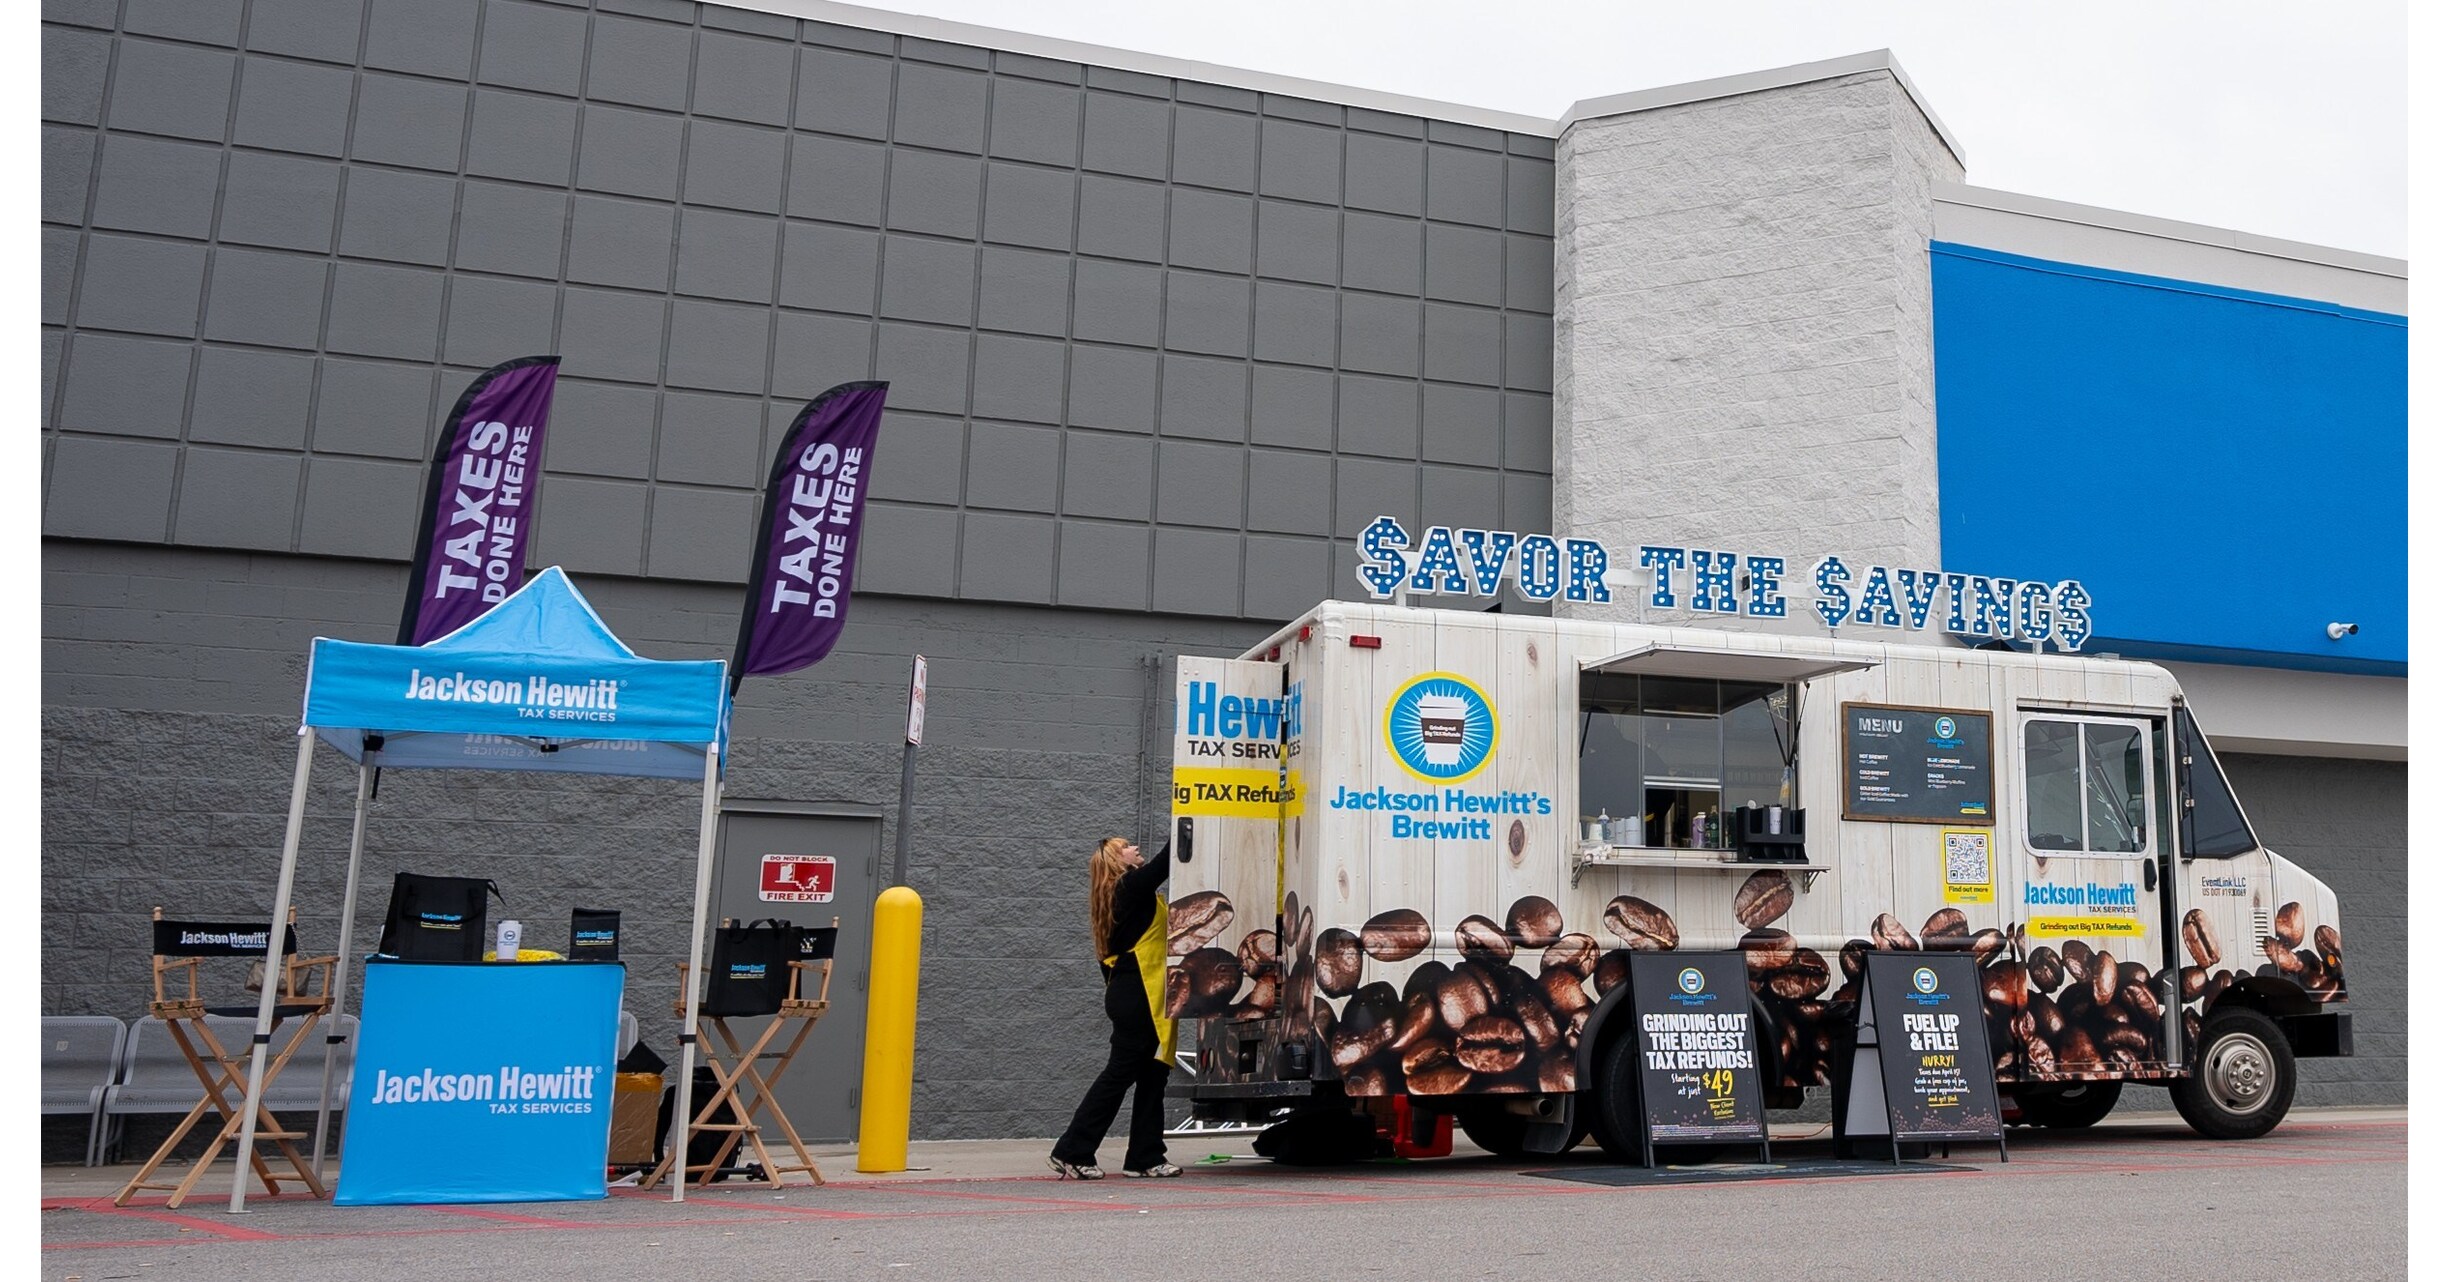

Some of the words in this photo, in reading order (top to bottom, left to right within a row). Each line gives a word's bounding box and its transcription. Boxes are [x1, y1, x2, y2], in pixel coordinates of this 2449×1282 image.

[498, 425, 533, 507] HERE
[829, 447, 863, 526] HERE
[435, 421, 509, 599] TAXES
[771, 442, 839, 614] TAXES
[482, 516, 516, 603] DONE
[813, 533, 847, 619] DONE
[1633, 545, 1788, 618] THE
[405, 668, 521, 704] Jackson
[527, 675, 619, 710] Hewitt
[517, 707, 545, 720] TAX
[548, 710, 617, 723] SERVICES
[1859, 717, 1903, 734] MENU
[1188, 740, 1226, 757] TAX
[1194, 783, 1233, 801] TAX
[1330, 786, 1439, 812] Jackson
[1445, 790, 1552, 815] Hewitt's
[1392, 815, 1491, 840] Brewitt
[2233, 876, 2247, 887] LLC
[766, 892, 795, 901] FIRE
[797, 893, 826, 901] EXIT
[2024, 881, 2084, 905] Jackson
[2087, 883, 2136, 906] Hewitt
[2088, 905, 2102, 913] TAX
[2040, 923, 2068, 932] Grinding
[2080, 923, 2091, 932] Big
[180, 931, 229, 945] Jackson
[229, 931, 267, 945] Hewitt
[1642, 1013, 1716, 1032] GRINDING
[1717, 1013, 1747, 1031] OUT
[1902, 1013, 1939, 1032] FUEL
[1938, 1013, 1960, 1032] UP
[1649, 1032, 1680, 1051] THE
[1681, 1032, 1745, 1050] BIGGEST
[1910, 1033, 1924, 1051] &
[1923, 1033, 1960, 1051] FILE!
[1646, 1051, 1676, 1070] TAX
[1677, 1051, 1753, 1070] REFUNDS!
[1671, 1073, 1700, 1085] Starting
[1941, 1068, 1953, 1077] April
[372, 1068, 493, 1104] Jackson
[499, 1066, 594, 1100] Hewitt
[1677, 1086, 1686, 1096] at
[1687, 1086, 1701, 1099] just
[1702, 1069, 1734, 1097] $49
[489, 1103, 517, 1114] TAX
[521, 1103, 592, 1114] SERVICES
